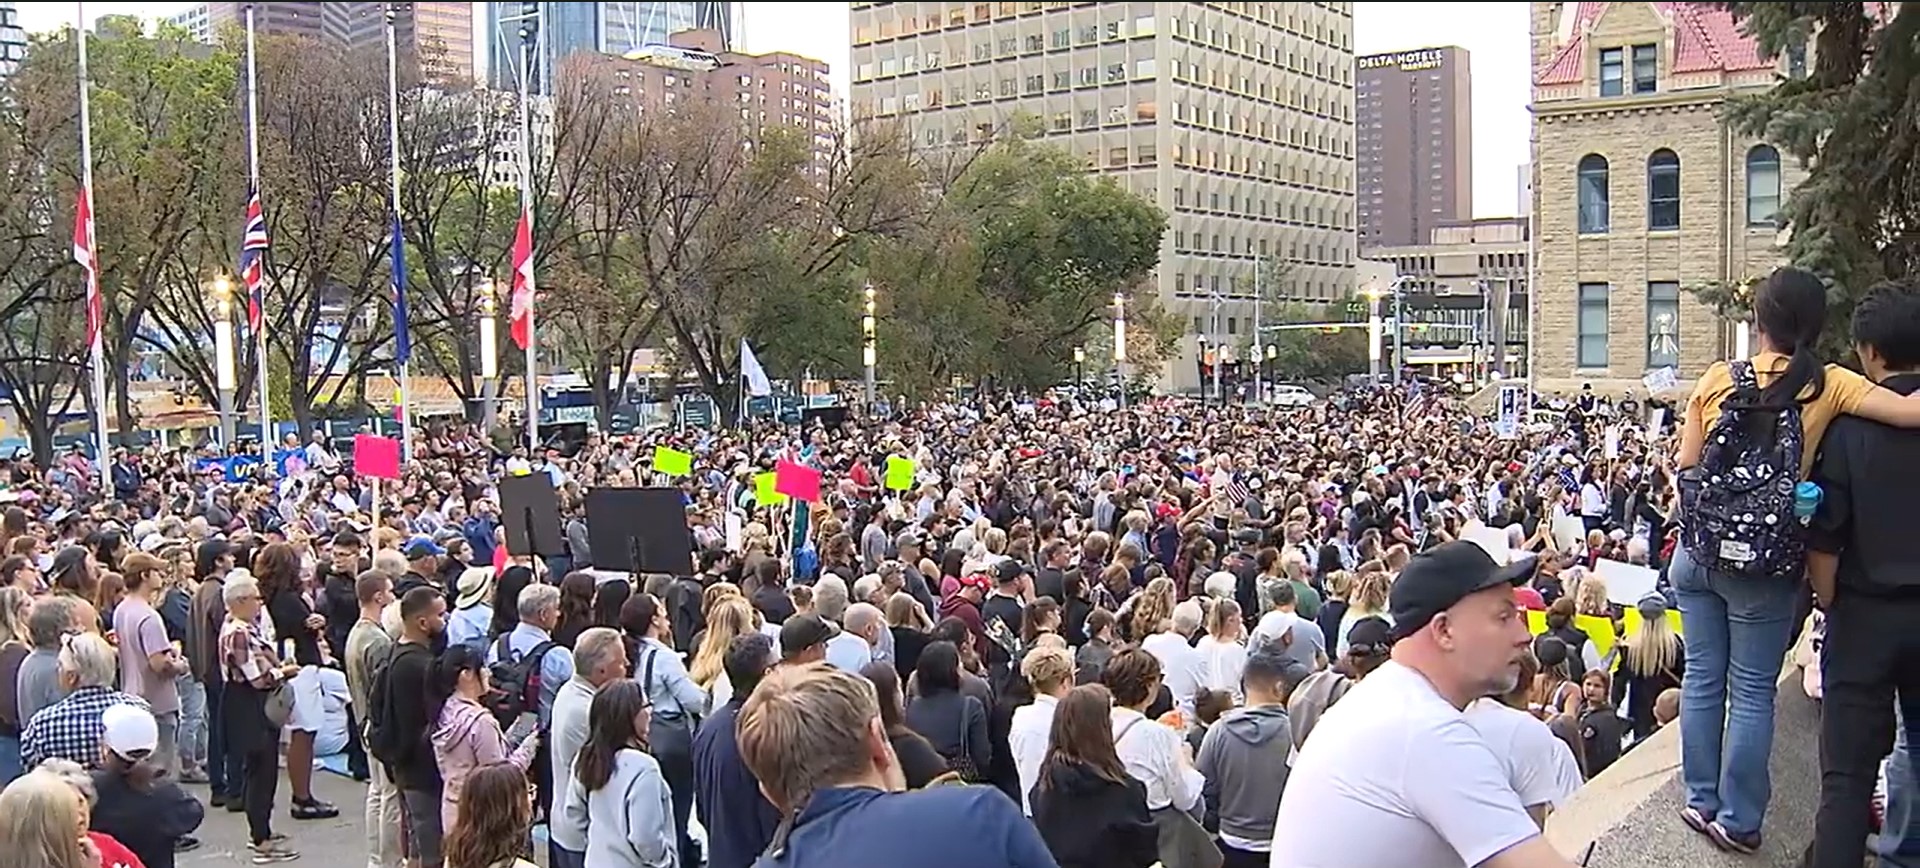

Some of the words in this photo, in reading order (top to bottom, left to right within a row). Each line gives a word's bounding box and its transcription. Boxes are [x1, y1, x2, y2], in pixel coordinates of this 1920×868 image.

[1359, 55, 1393, 69] DELTA
[1397, 50, 1442, 64] HOTELS
[234, 462, 281, 479] VOE
